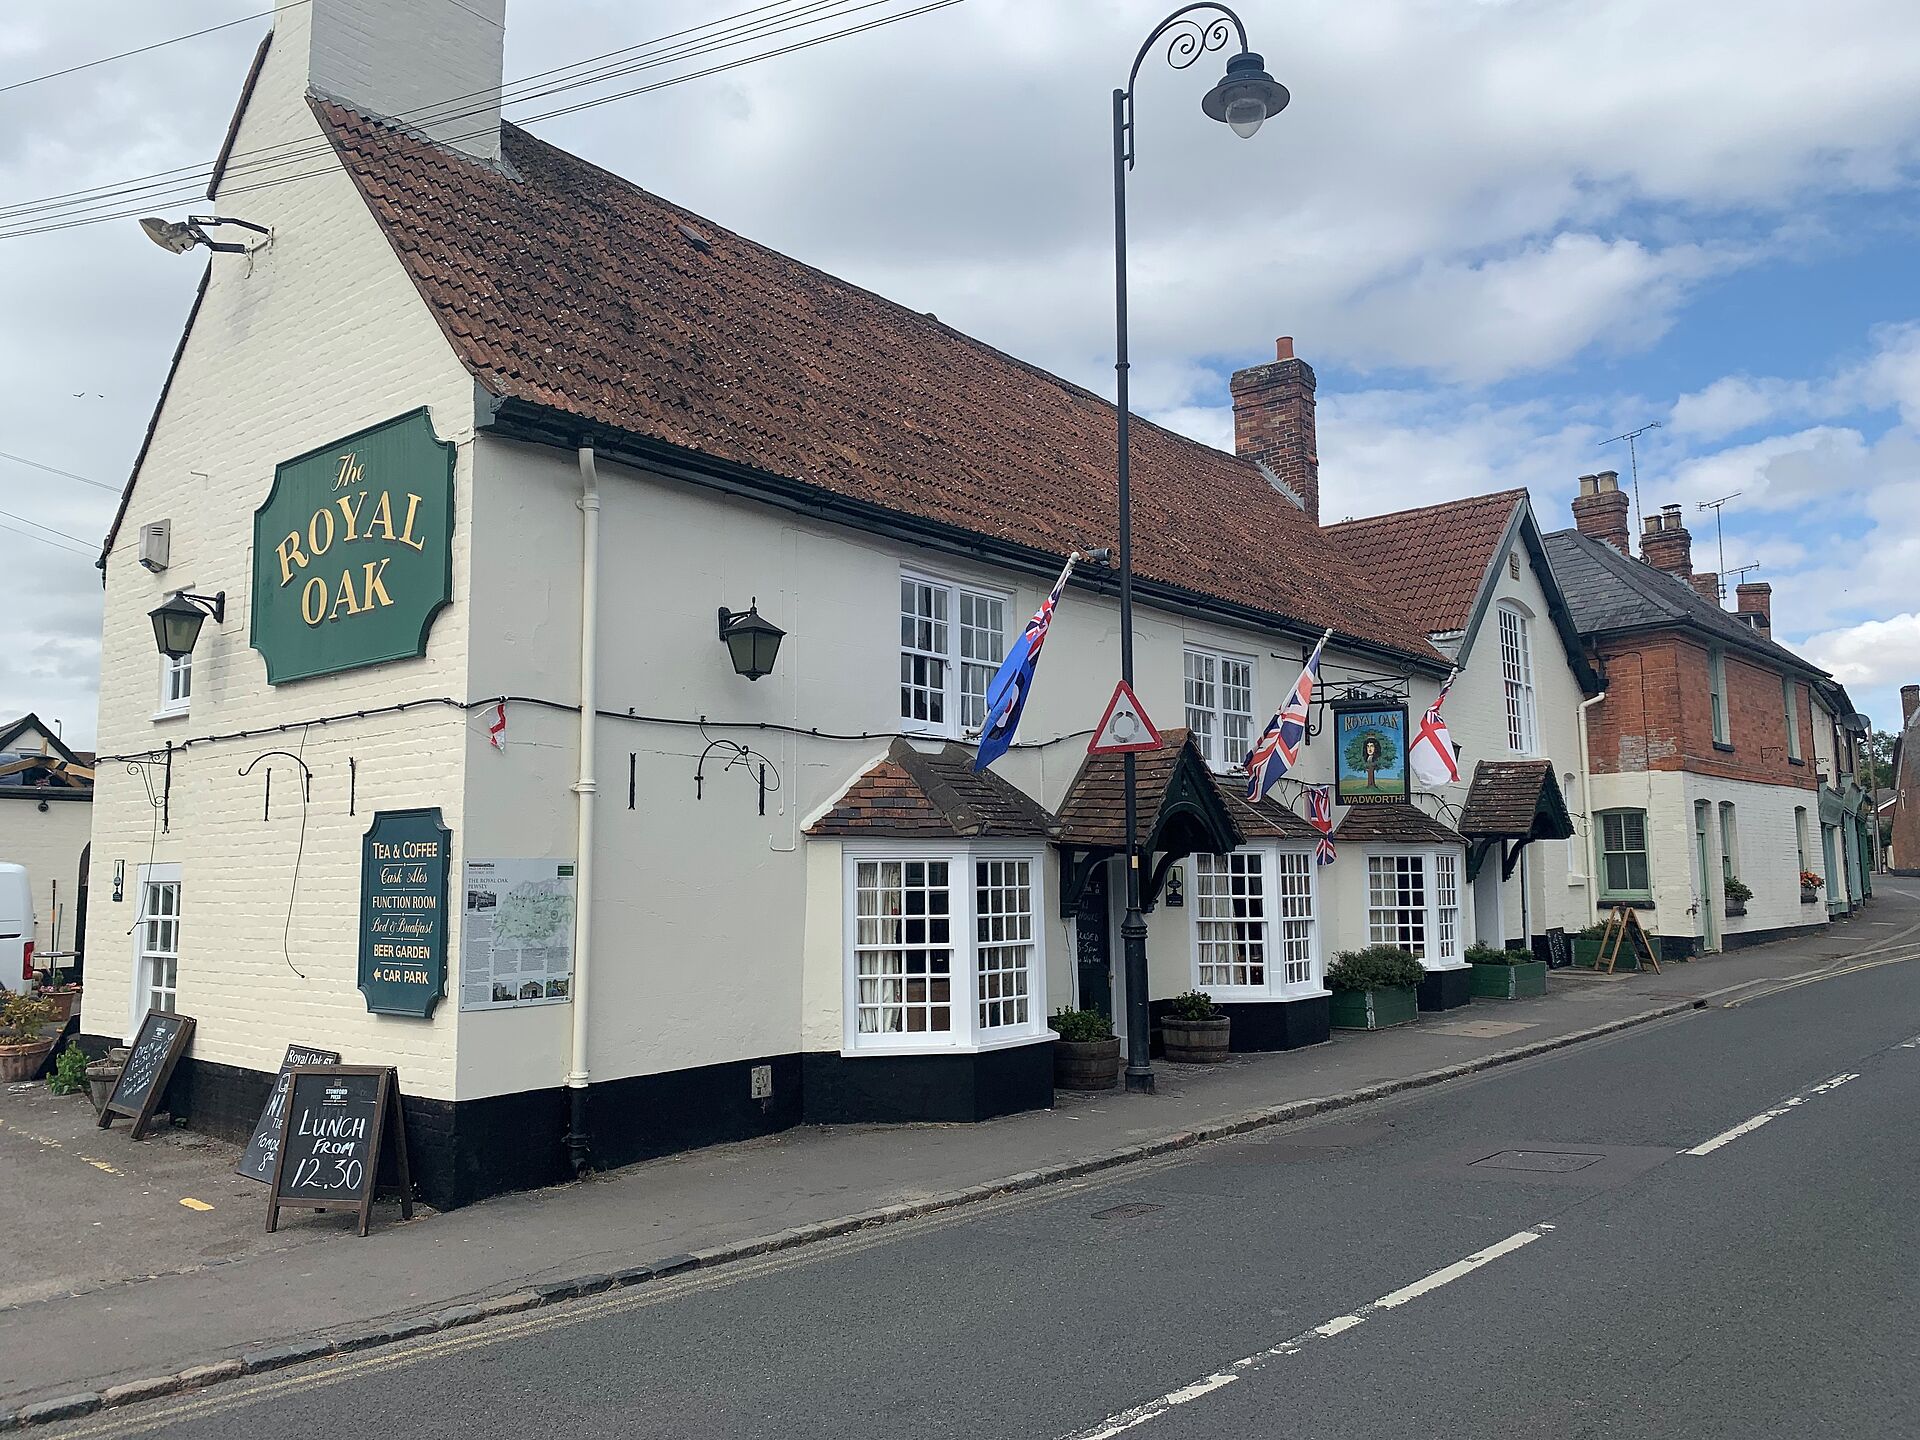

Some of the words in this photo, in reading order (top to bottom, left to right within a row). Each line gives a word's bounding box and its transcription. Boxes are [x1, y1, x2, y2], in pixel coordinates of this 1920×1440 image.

[331, 451, 366, 492] The
[275, 490, 425, 587] ROYAL
[301, 557, 395, 625] OAK
[1344, 714, 1376, 733] ROYAL
[1378, 712, 1399, 731] OAK
[392, 843, 401, 859] &
[380, 866, 403, 885] Cask
[406, 866, 428, 884] Ales
[372, 895, 411, 909] FUNCTION
[412, 895, 436, 909] ROOM
[370, 916, 390, 933] Bed
[396, 917, 434, 938] Breakfast
[373, 943, 394, 958] BEER
[395, 944, 430, 960] GARDEN
[383, 968, 401, 983] CAR
[403, 970, 429, 985] PARK
[286, 1049, 310, 1065] Royal
[308, 1053, 323, 1065] Oak
[298, 1108, 366, 1139] LUNCH
[311, 1137, 356, 1157] FROM
[290, 1158, 363, 1190] 12.30
